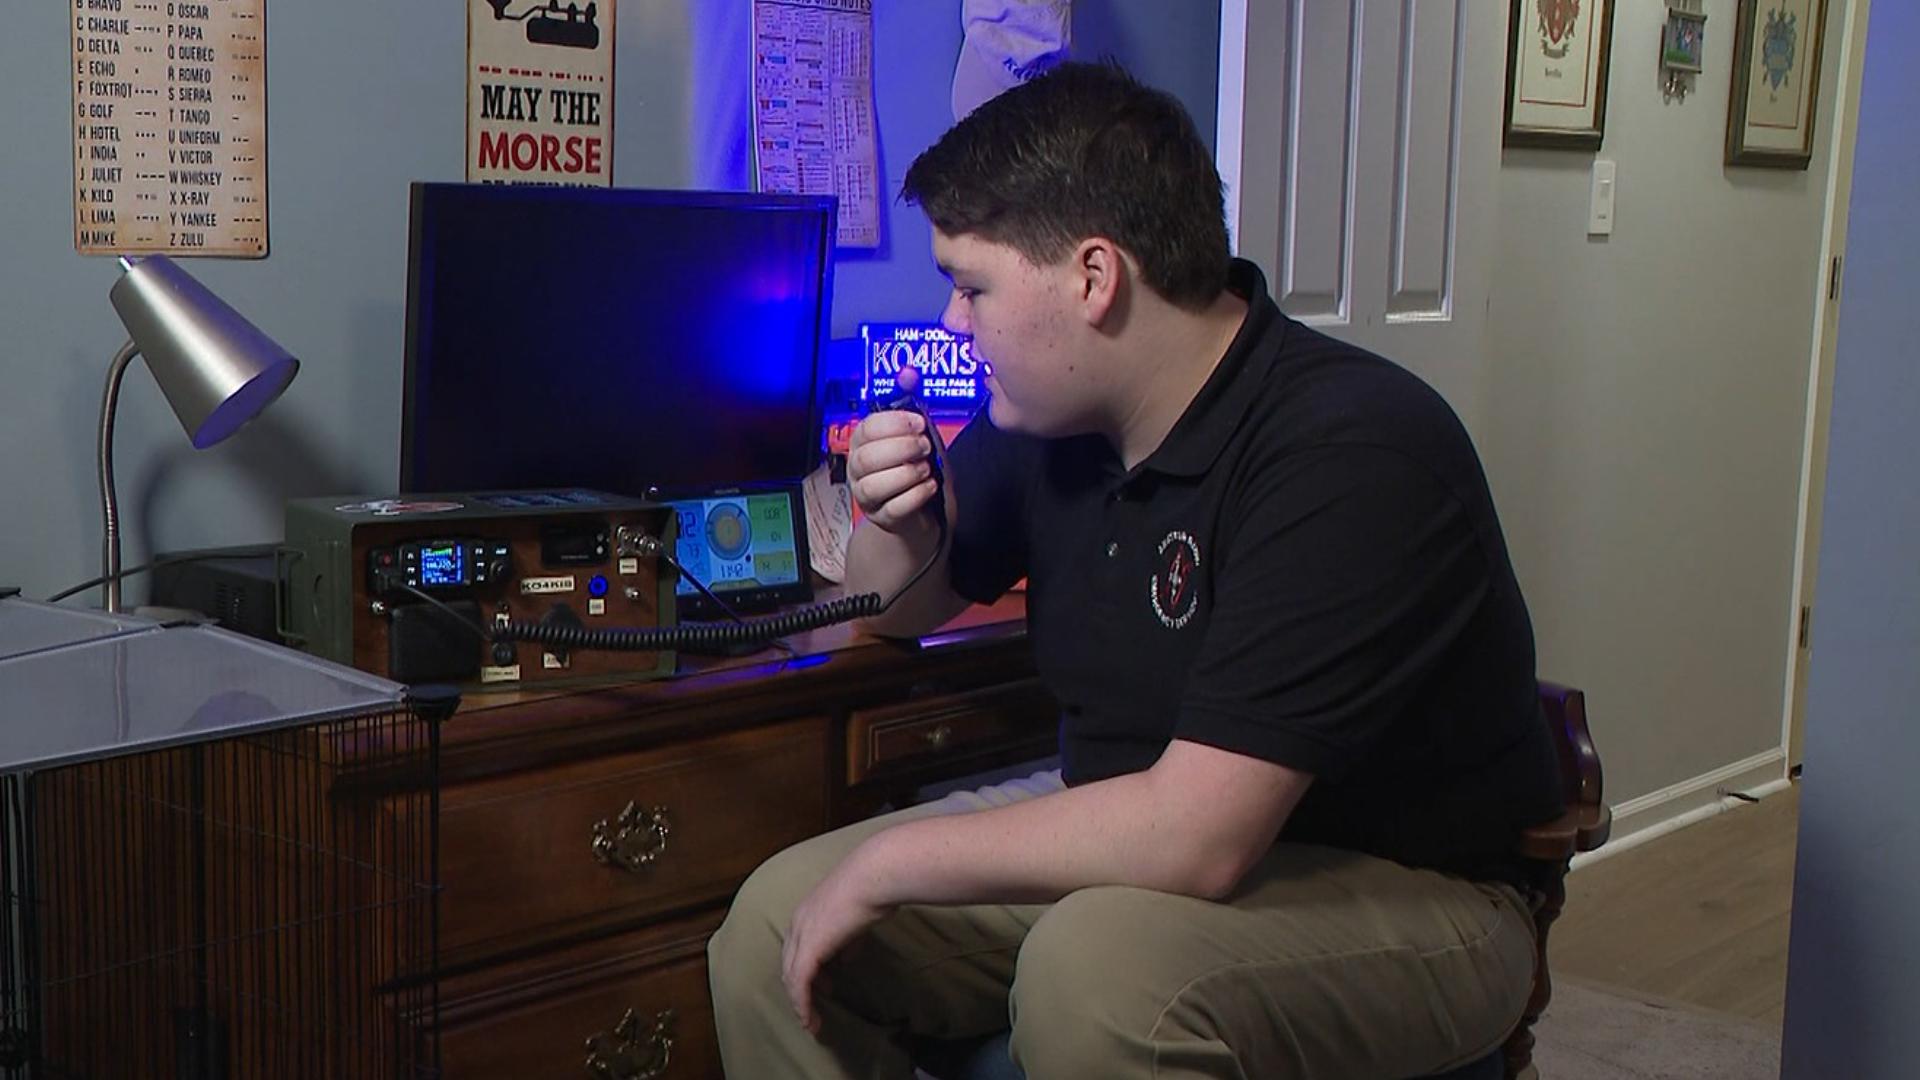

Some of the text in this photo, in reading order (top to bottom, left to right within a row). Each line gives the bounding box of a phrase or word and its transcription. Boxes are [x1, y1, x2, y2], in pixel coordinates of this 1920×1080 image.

[167, 2, 209, 20] O OSCAR
[76, 16, 129, 36] C CHARLIE
[167, 24, 203, 41] P PAPA
[76, 36, 120, 55] D DELTA
[167, 44, 214, 62] Q QUEBEC
[77, 59, 116, 77] E ECHO
[167, 65, 211, 84] R ROMEO
[77, 80, 132, 99] F FOXTROT
[168, 86, 212, 103] S SIERRA
[78, 102, 114, 119] G GOLF
[481, 84, 600, 126] MAY THE
[168, 109, 211, 125] T TANGO
[78, 125, 121, 142] H HOTEL
[168, 129, 220, 145] U UNIFORM
[79, 145, 117, 161] I INDIA
[168, 149, 213, 164] V VICTOR
[479, 131, 602, 174] MORSE
[79, 167, 122, 183] J JULIET
[169, 170, 222, 186] W WHISKEY
[79, 188, 113, 203] K KILO
[169, 191, 209, 206] X X-RAY
[80, 209, 116, 225] L LIMA
[170, 212, 217, 227] Y YANKEE
[80, 231, 115, 246] M MIKE
[170, 232, 204, 247] Z ZULU
[873, 341, 977, 375] KO4KIS
